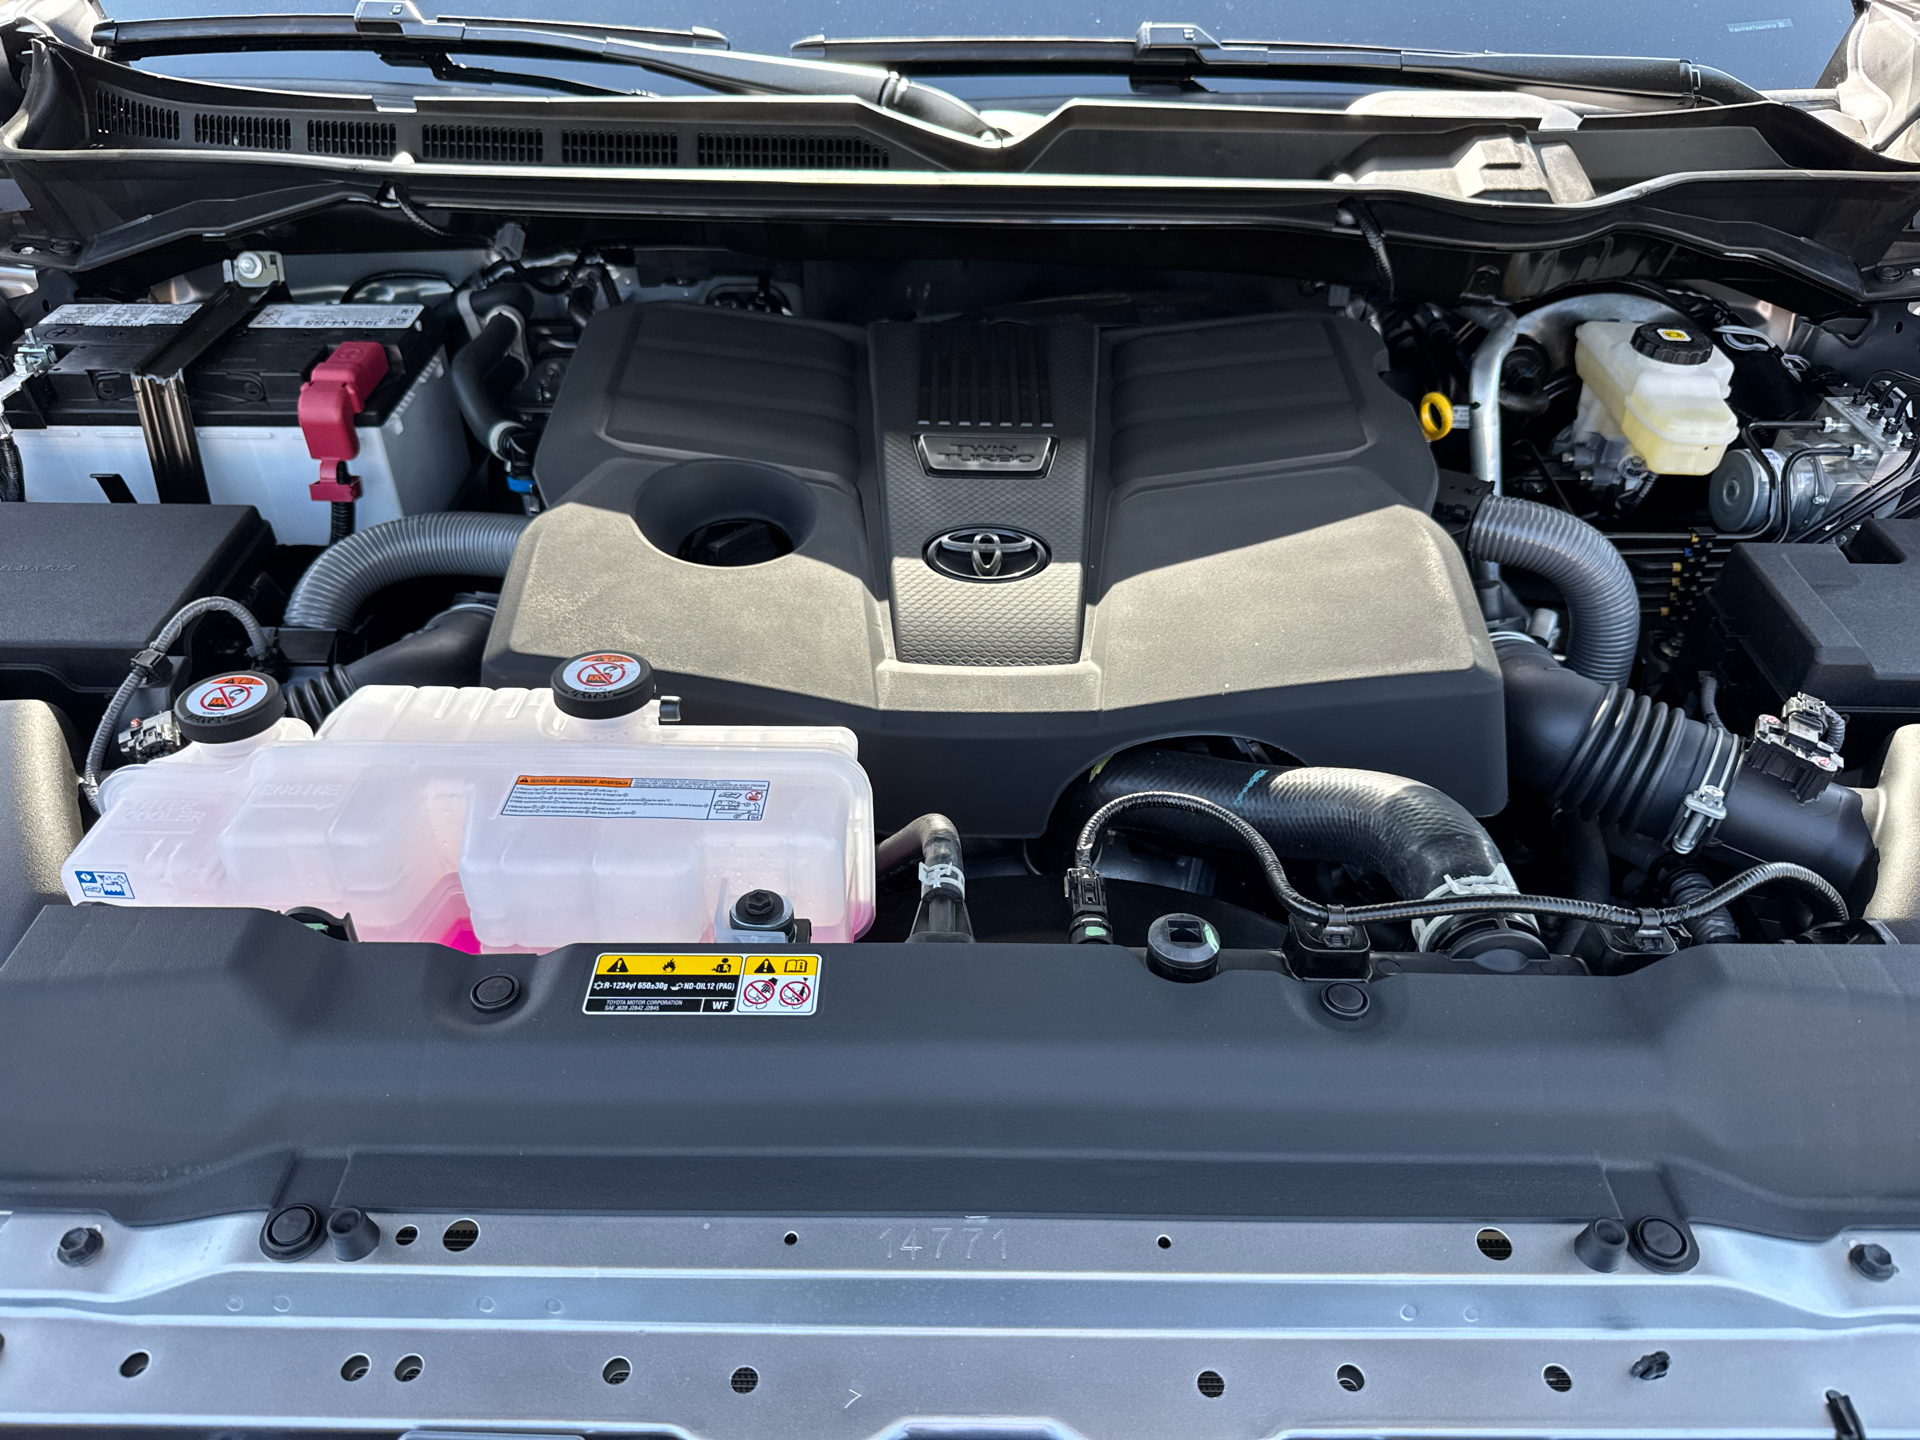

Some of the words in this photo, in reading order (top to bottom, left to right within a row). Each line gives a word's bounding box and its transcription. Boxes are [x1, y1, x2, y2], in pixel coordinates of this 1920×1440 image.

[949, 443, 1018, 453] TWIN
[937, 452, 1036, 463] TURBO
[0, 564, 33, 573] ELAY
[43, 564, 79, 573] FUSE
[258, 782, 343, 797] ENGINE
[125, 809, 207, 825] COOLER
[603, 981, 637, 991] R-1234yf
[637, 981, 669, 991] 650±30g
[715, 982, 735, 991] (PAG)
[712, 1001, 730, 1010] WF
[879, 1227, 1007, 1261] 14771
